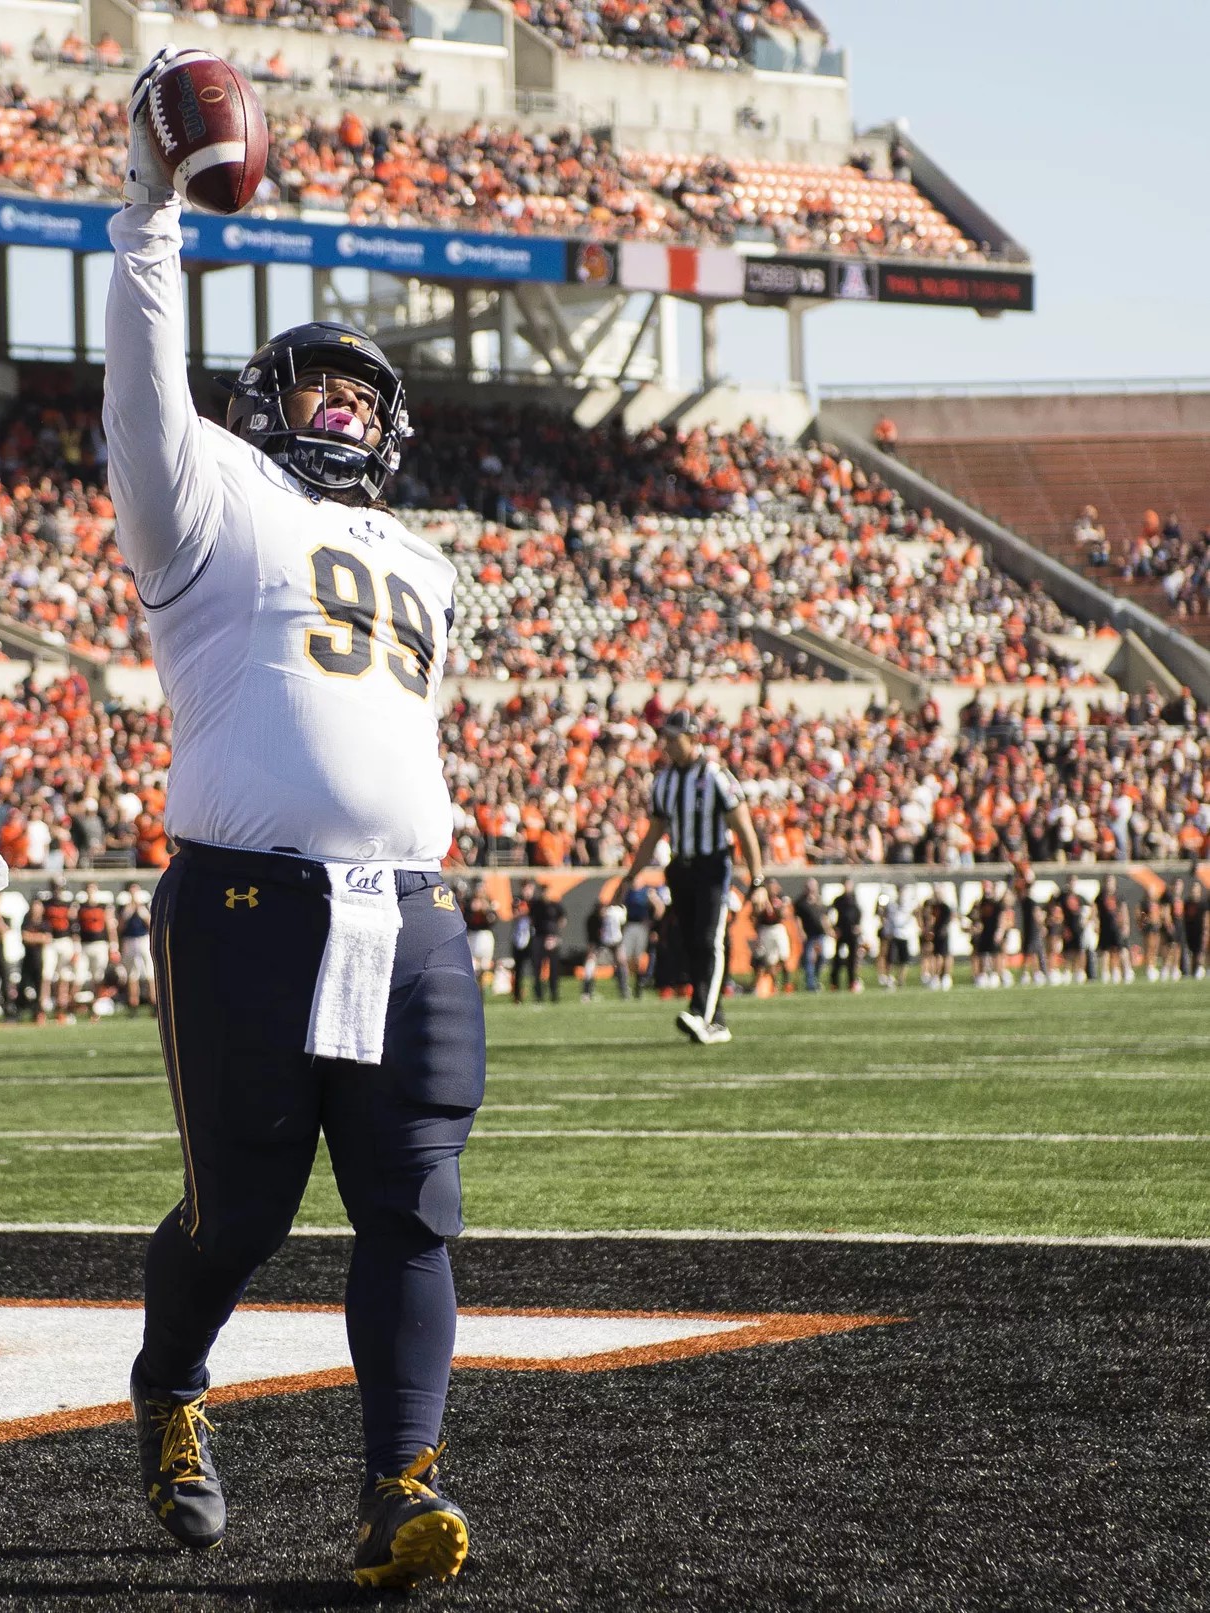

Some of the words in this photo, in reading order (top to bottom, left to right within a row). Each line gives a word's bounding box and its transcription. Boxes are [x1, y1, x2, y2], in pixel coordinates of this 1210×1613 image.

[304, 543, 436, 704] 99
[346, 865, 383, 896] Cal
[433, 886, 456, 912] Cal
